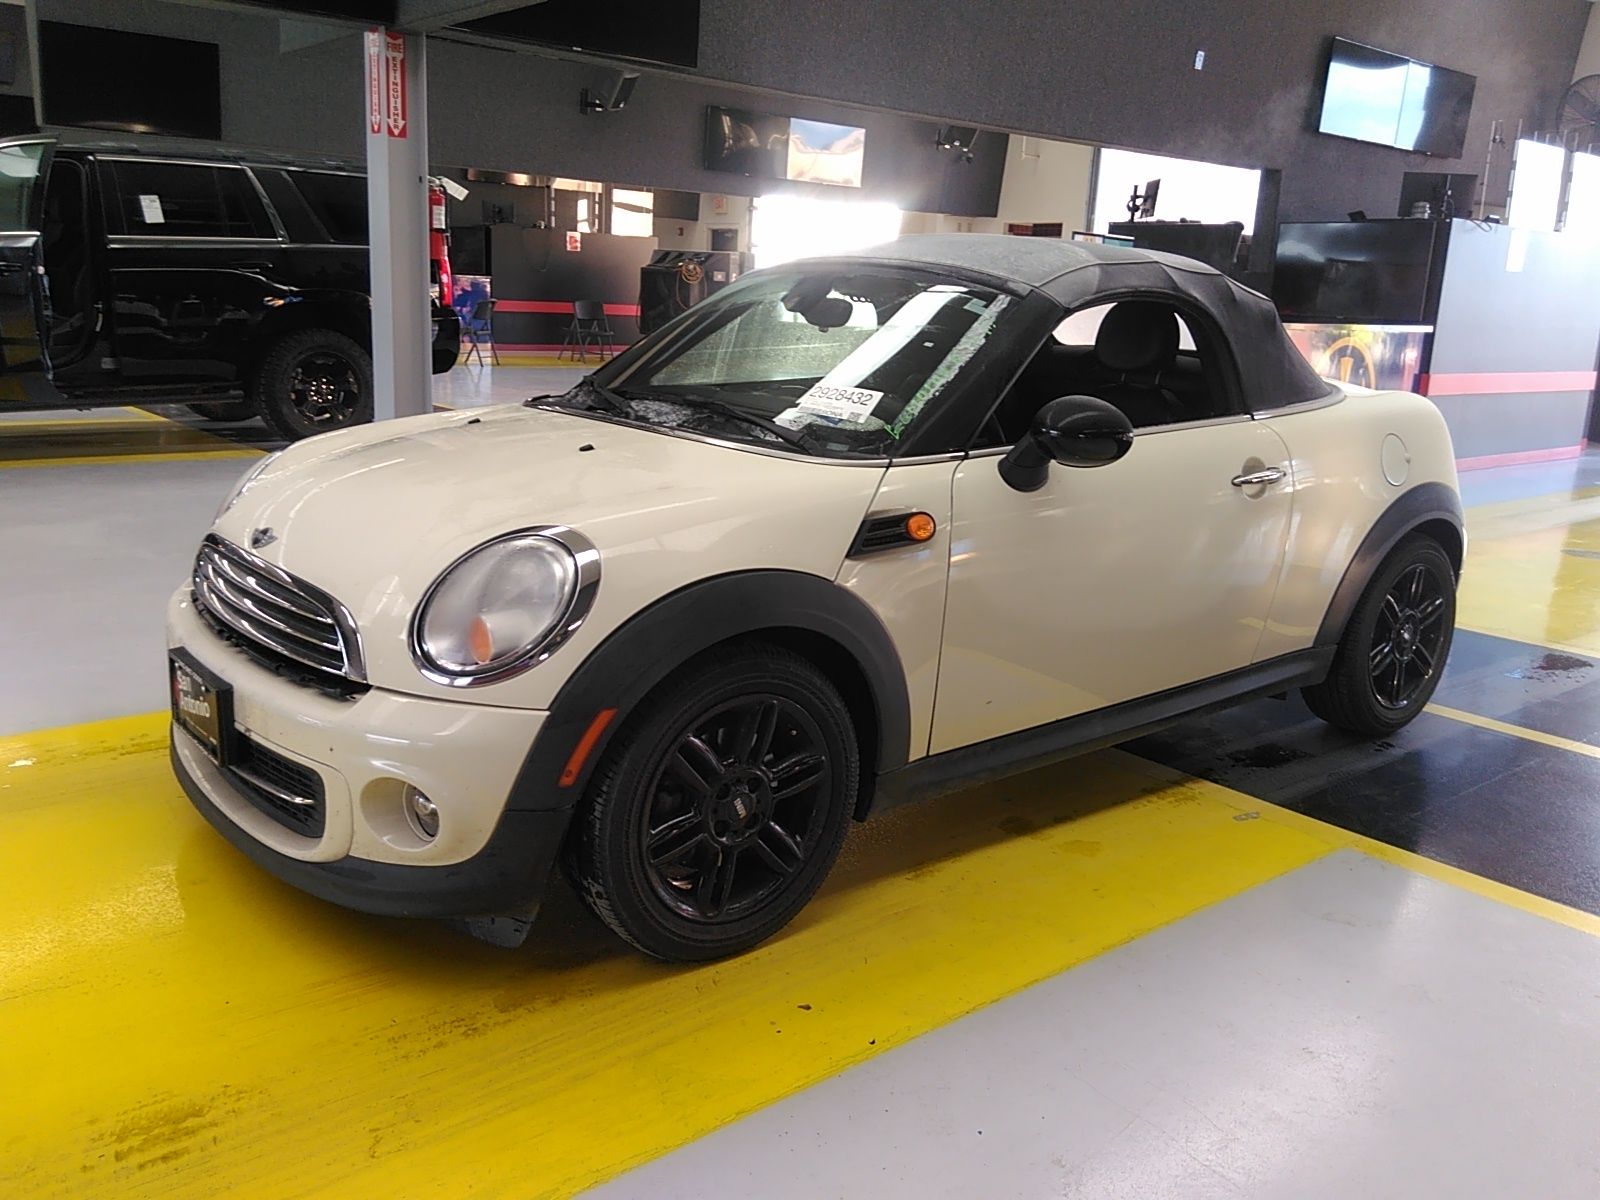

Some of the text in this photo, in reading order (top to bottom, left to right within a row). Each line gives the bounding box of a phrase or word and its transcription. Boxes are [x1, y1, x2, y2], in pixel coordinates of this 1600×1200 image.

[387, 42, 403, 53] FIRE
[391, 56, 400, 130] EXTINGUISHER
[809, 386, 873, 406] 2928432
